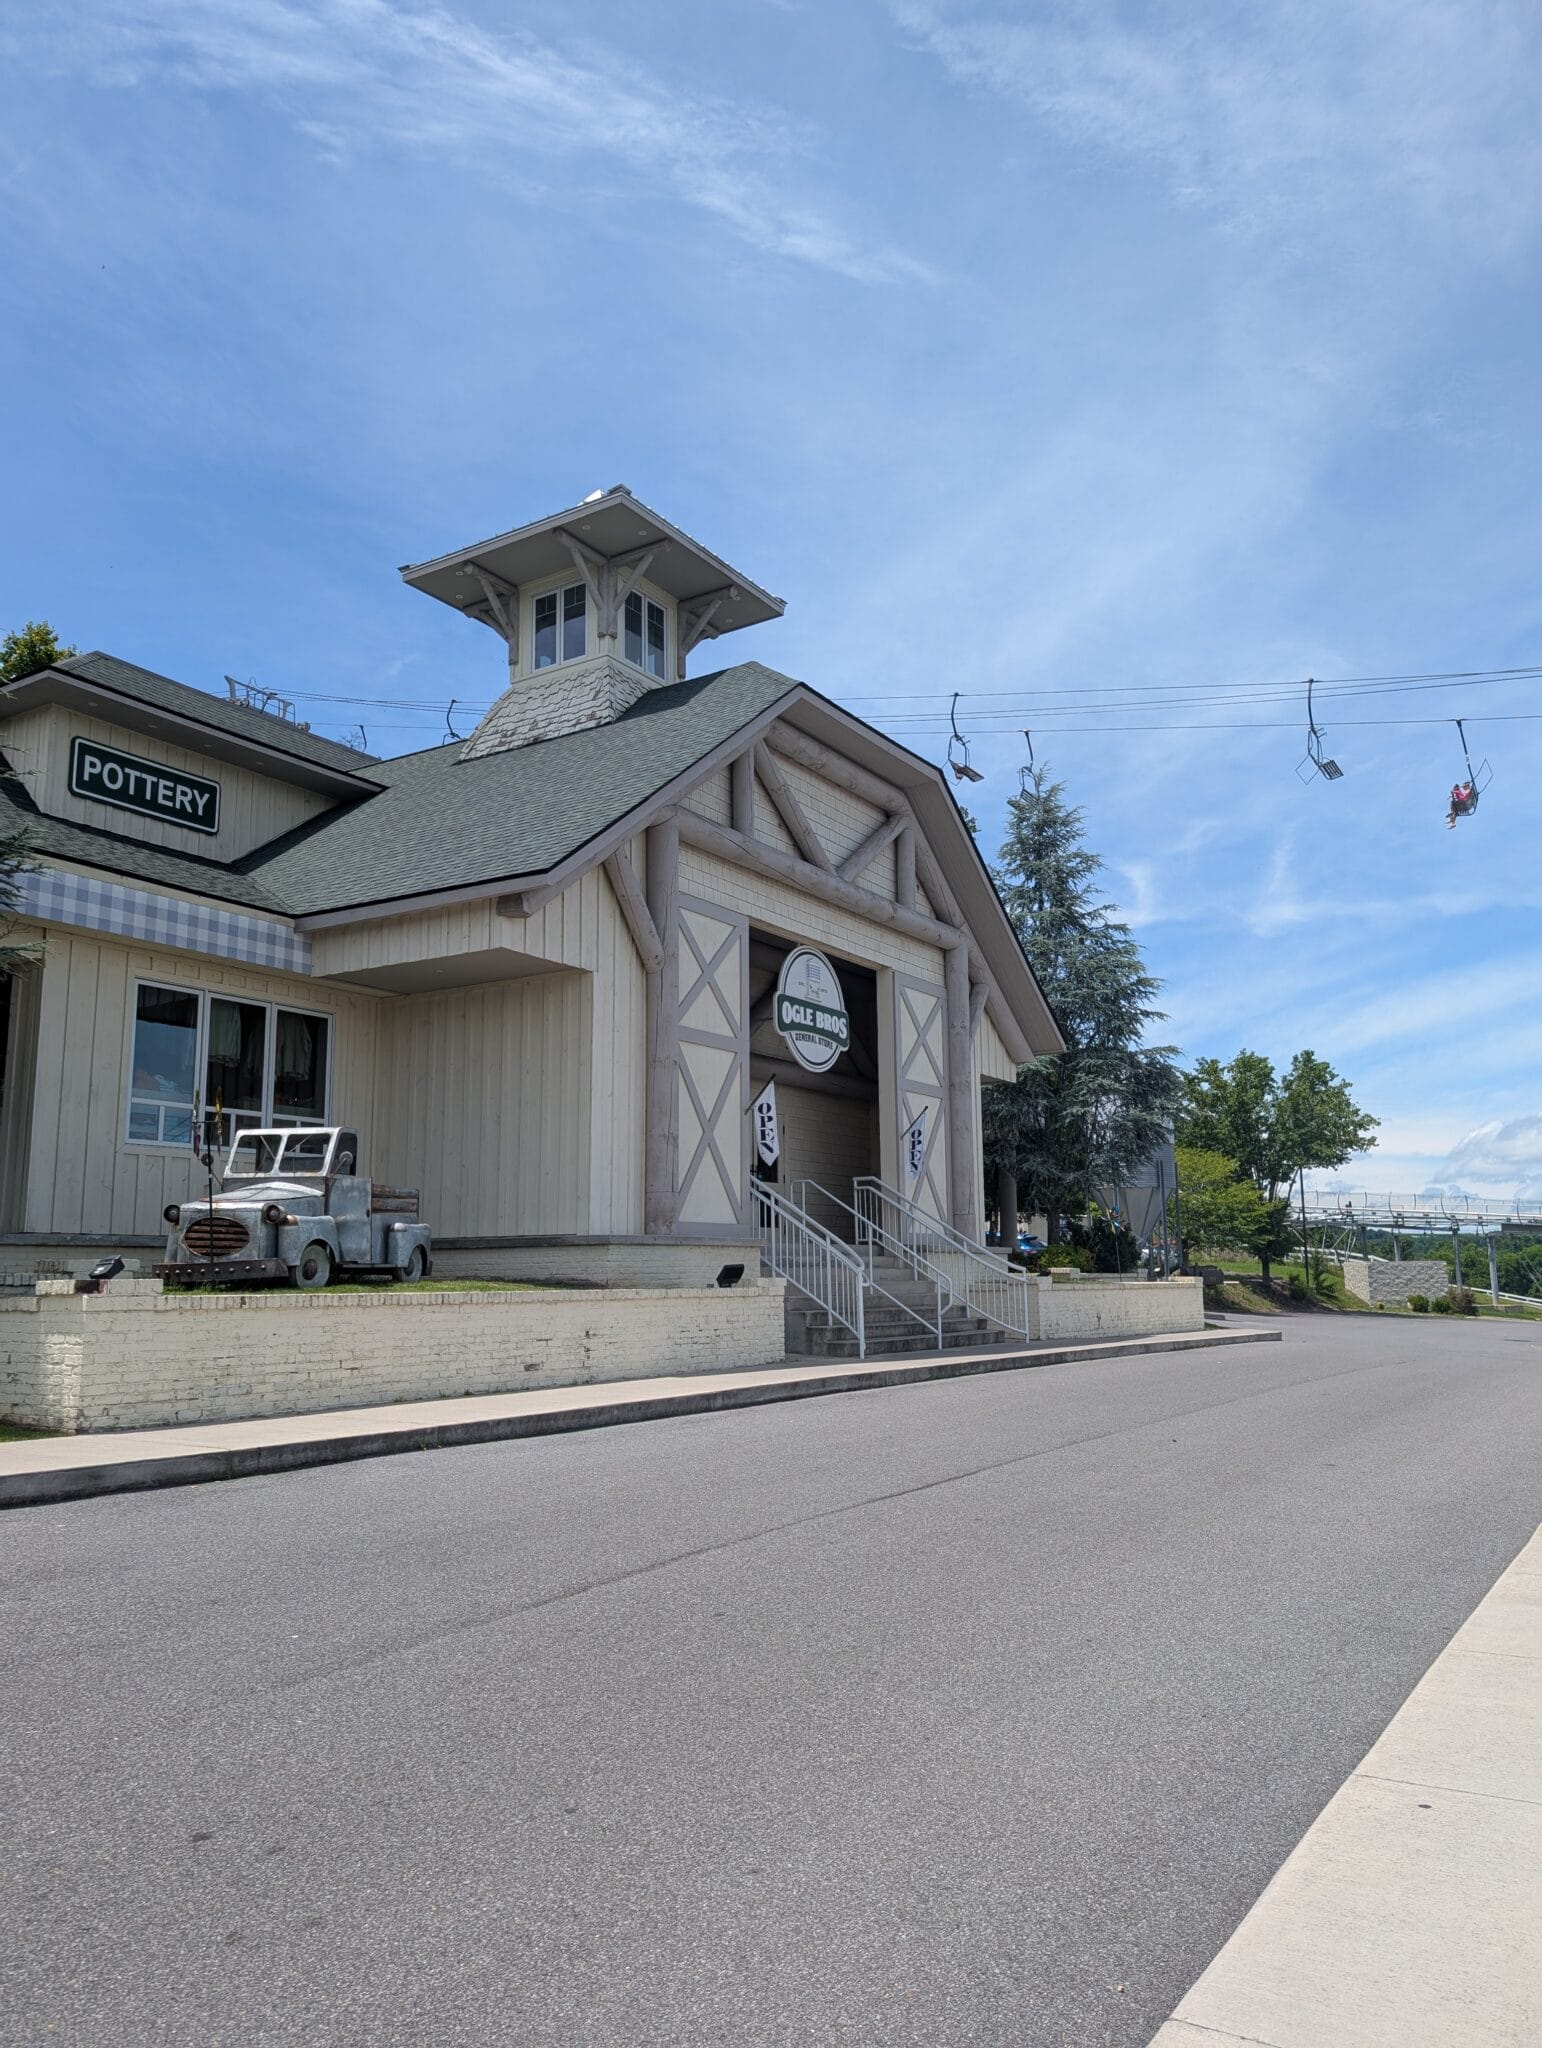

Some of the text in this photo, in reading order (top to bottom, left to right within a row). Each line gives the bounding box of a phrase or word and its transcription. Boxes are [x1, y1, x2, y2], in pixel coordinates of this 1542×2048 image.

[82, 755, 210, 816] POTTERY
[782, 1001, 848, 1039] OGLE BROS
[795, 1033, 833, 1050] GENERAL STORE
[758, 1102, 775, 1154] OPEN
[910, 1129, 922, 1172] OPEN
